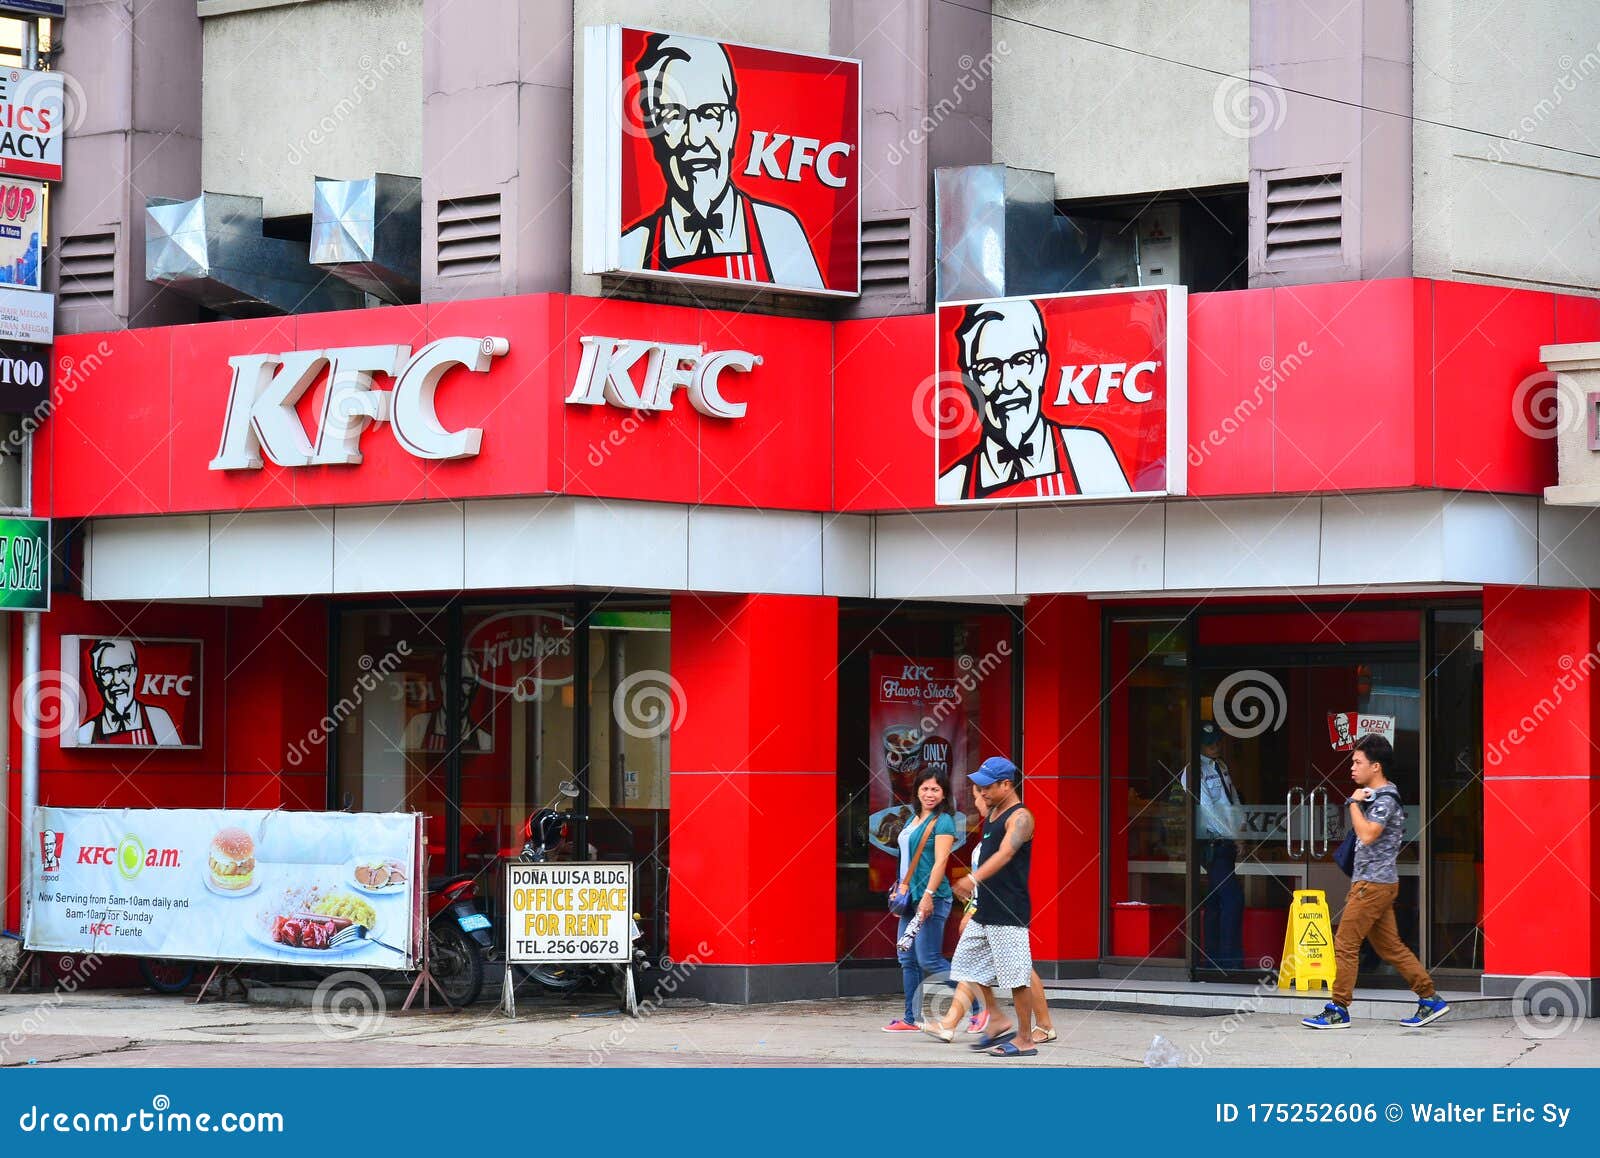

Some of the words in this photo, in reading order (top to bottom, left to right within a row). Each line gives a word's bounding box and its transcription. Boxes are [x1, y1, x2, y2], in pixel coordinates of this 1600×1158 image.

[743, 129, 851, 188] KFC
[565, 336, 754, 419] KFC
[1052, 361, 1157, 406] KFC
[207, 336, 492, 471] KFC
[9, 536, 41, 590] SPA
[901, 665, 934, 680] KFC
[139, 673, 193, 696] KFC
[883, 680, 921, 698] Flavor
[1360, 719, 1391, 729] OPEN
[923, 744, 948, 761] ONLY
[77, 846, 117, 866] KFC
[513, 869, 548, 885] DOÑA
[552, 870, 591, 885] LUISA
[593, 870, 628, 885] BLDG.
[38, 892, 54, 902] Now
[55, 893, 88, 906] Serving
[89, 894, 107, 905] from
[108, 895, 150, 906] 5am-10am
[152, 896, 172, 910] daily
[173, 898, 189, 908] and
[513, 888, 574, 911] OFFICE
[578, 888, 627, 911] SPACE
[65, 908, 106, 920] 8am-10am
[107, 910, 120, 921] for
[122, 910, 154, 924] Sunday
[524, 914, 560, 937] FOR
[564, 914, 612, 937] RENT
[1298, 912, 1323, 920] CAUTION
[80, 925, 88, 934] at
[89, 923, 113, 936] KFC
[114, 926, 143, 937] Fuente
